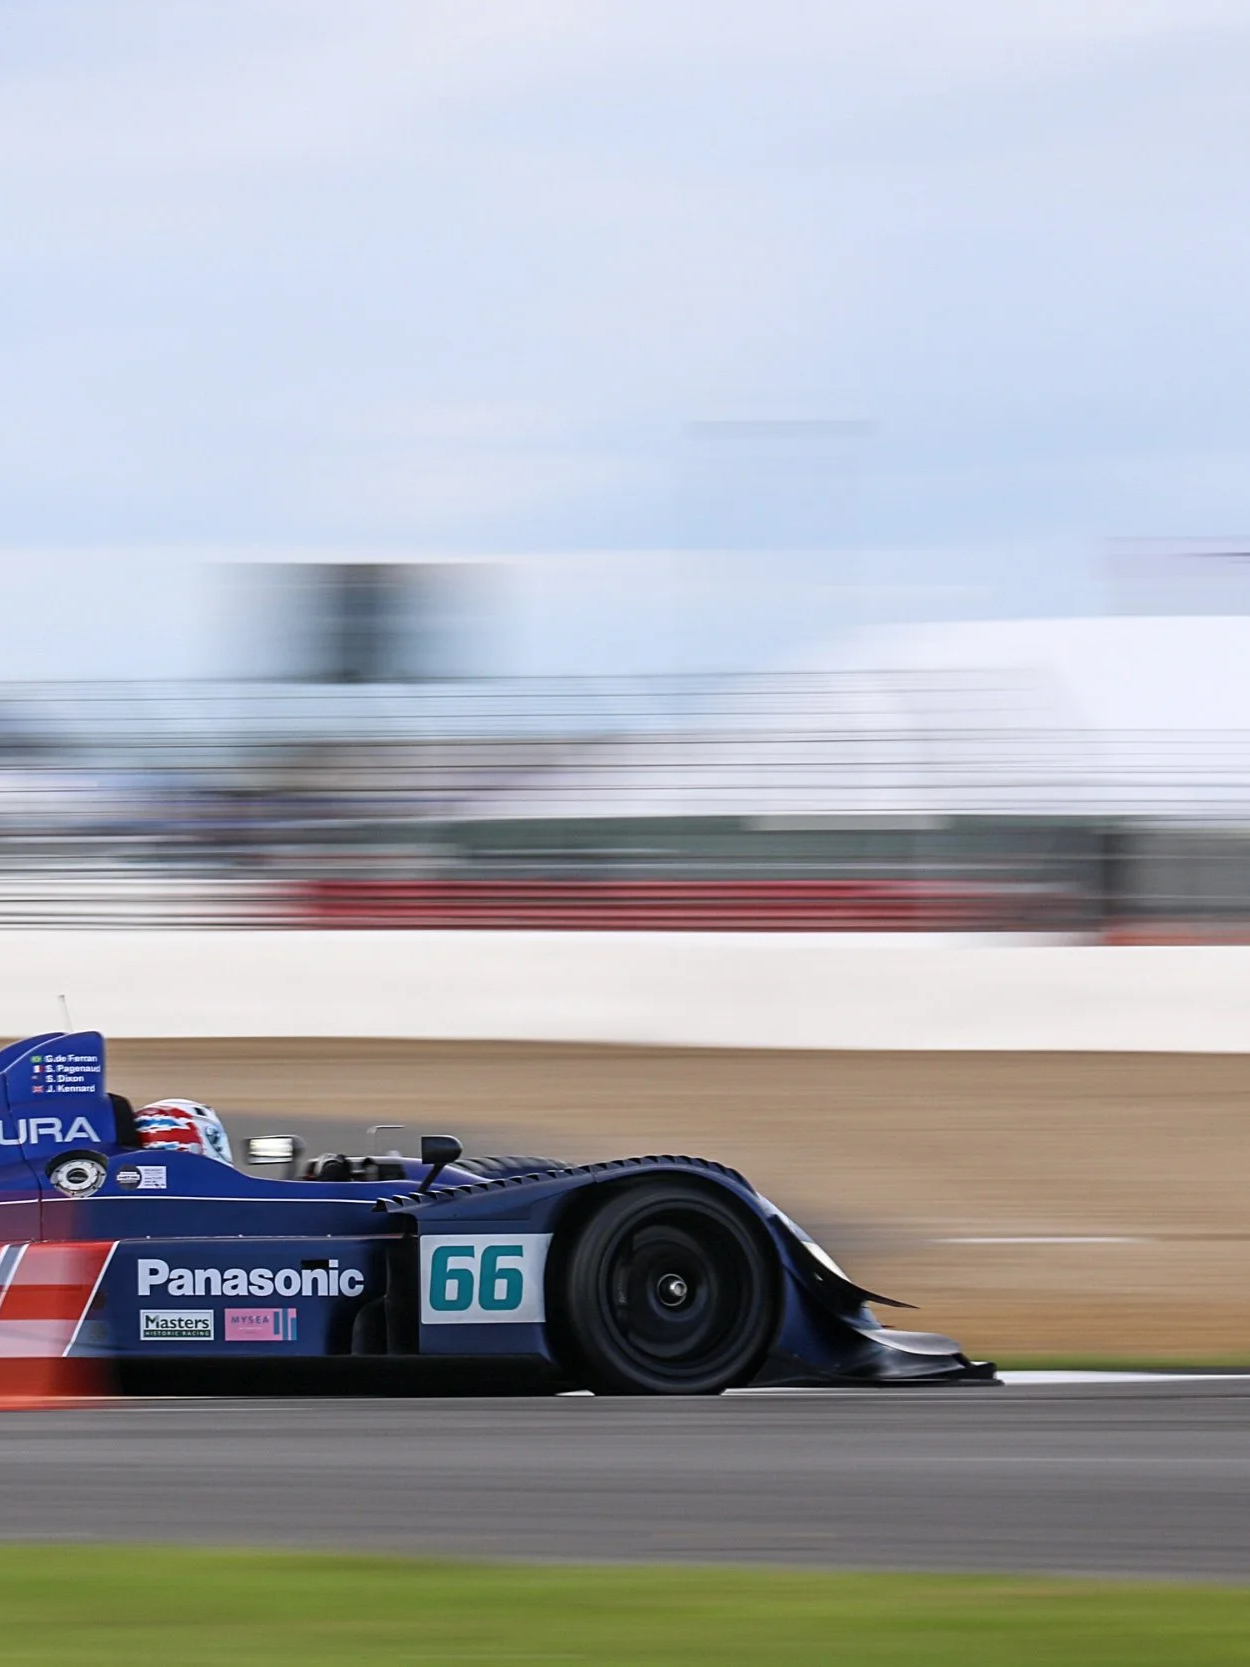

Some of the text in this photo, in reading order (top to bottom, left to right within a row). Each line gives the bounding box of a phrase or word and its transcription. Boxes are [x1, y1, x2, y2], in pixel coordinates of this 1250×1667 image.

[67, 1054, 98, 1063] Ferran
[44, 1064, 101, 1074] S. Pagenaud
[45, 1075, 84, 1083] S. Dixon
[45, 1085, 95, 1093] J. Kennard
[137, 1258, 365, 1297] Panasonic
[429, 1245, 524, 1311] 66
[145, 1314, 210, 1329] Masters
[231, 1315, 270, 1324] MYSEA
